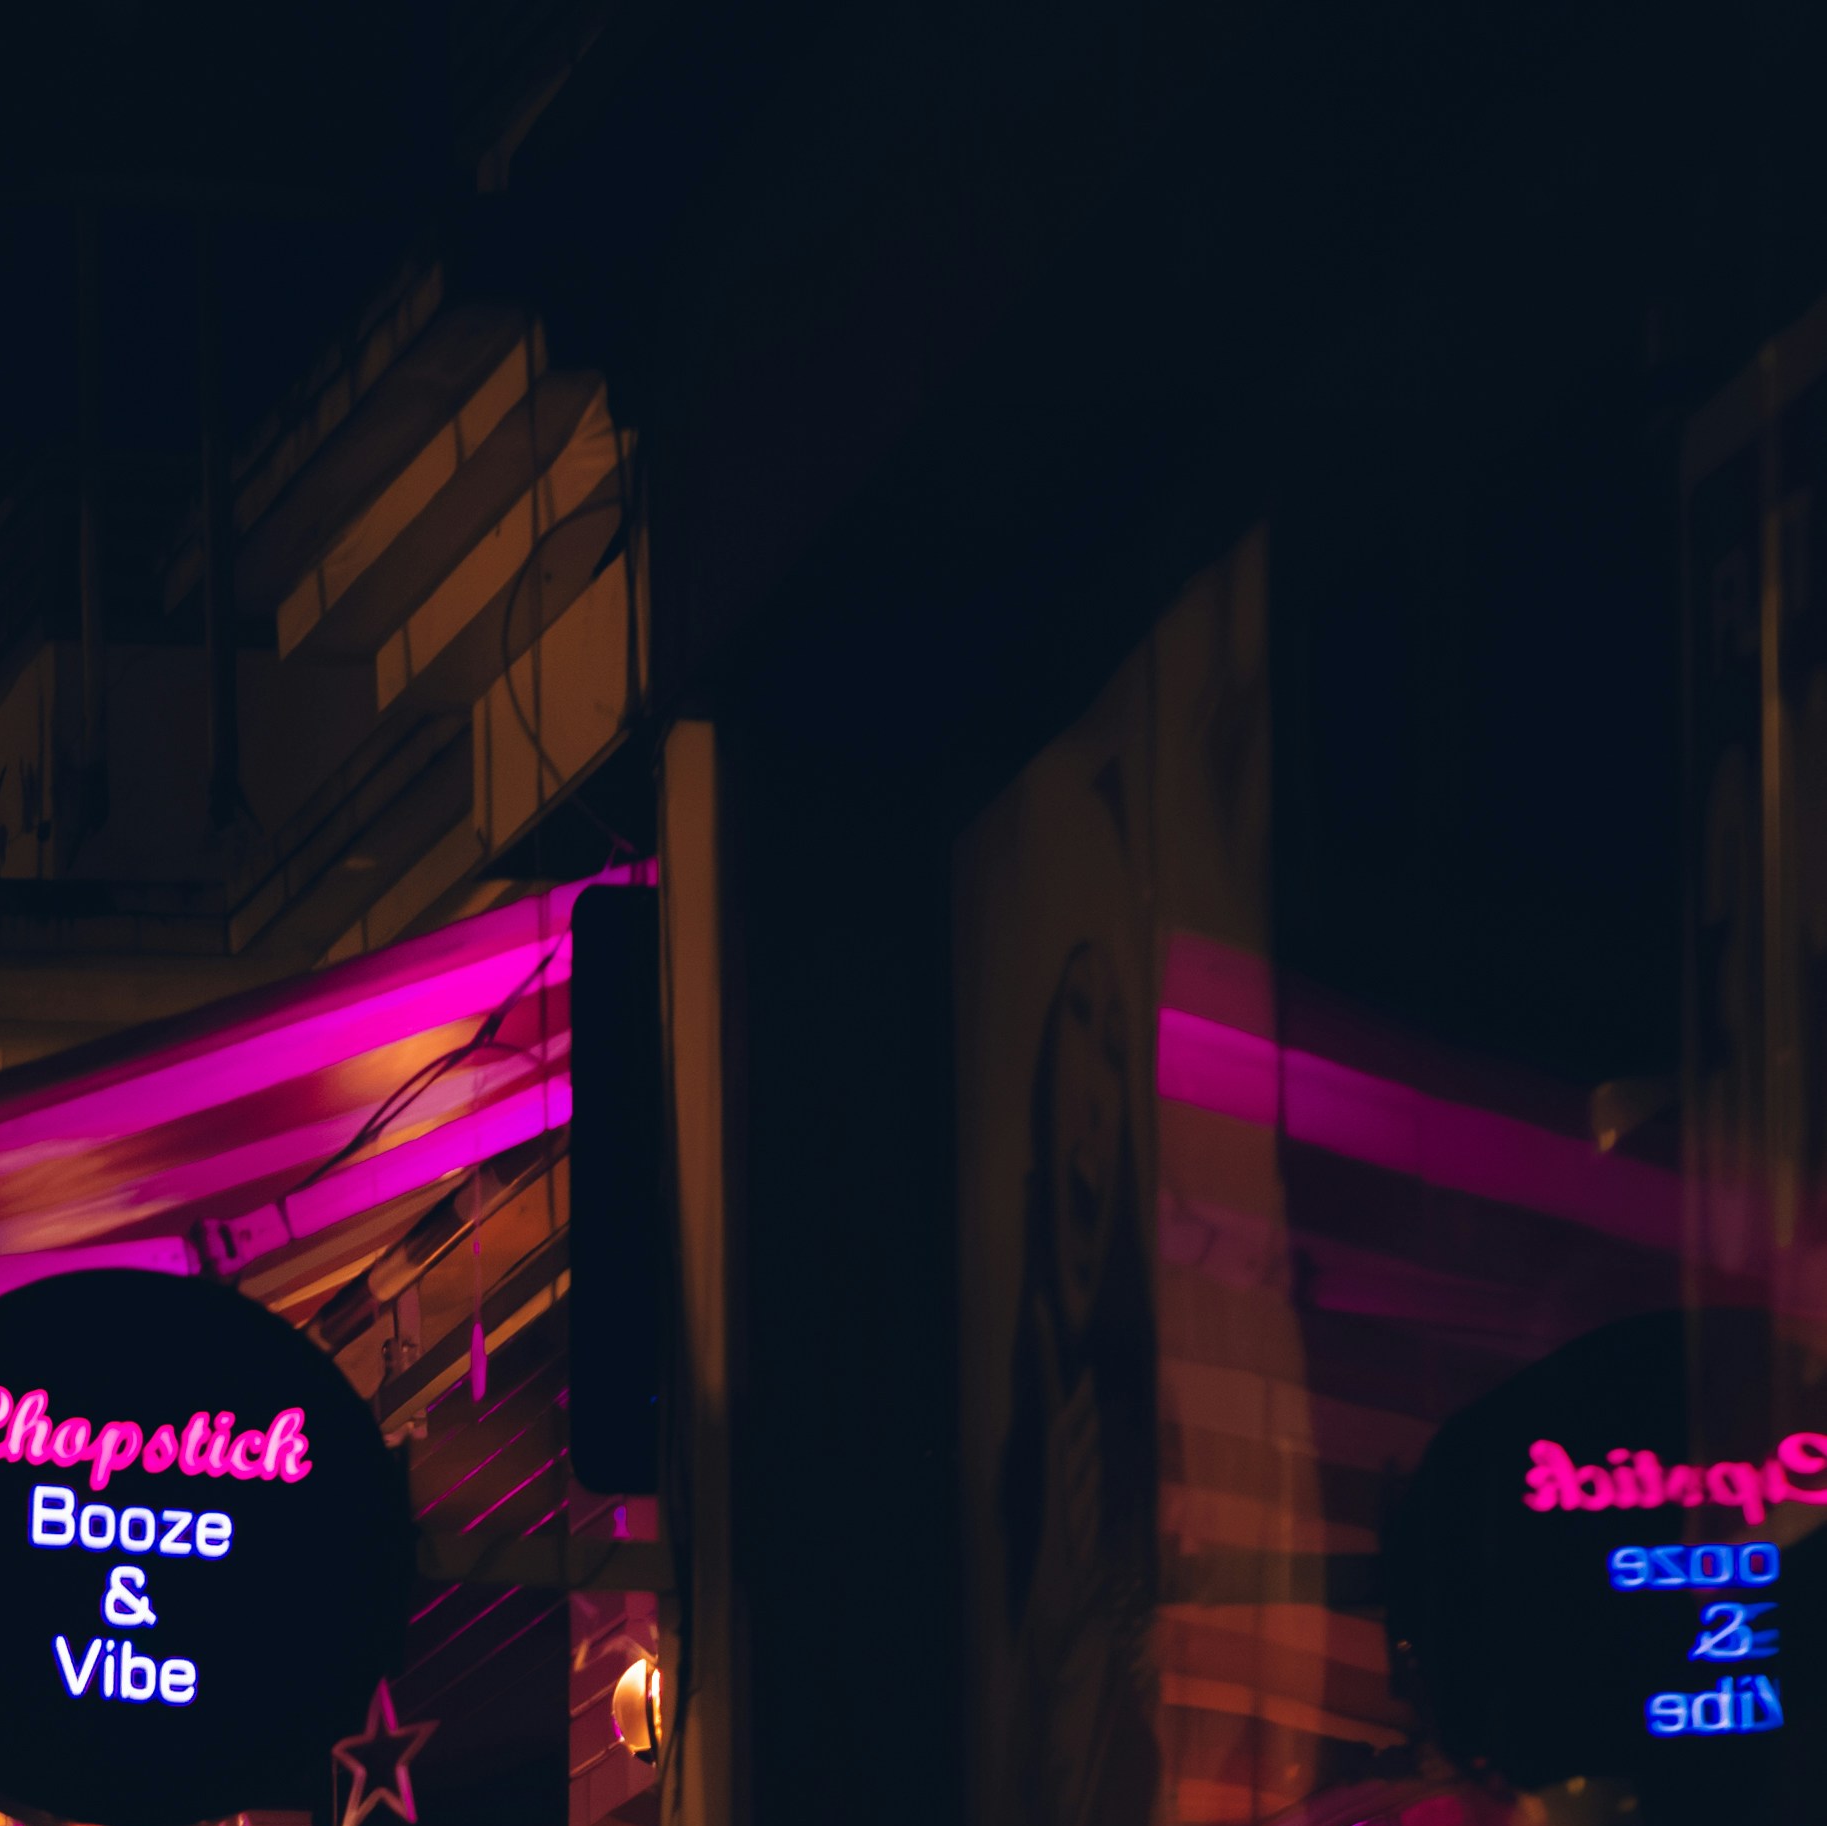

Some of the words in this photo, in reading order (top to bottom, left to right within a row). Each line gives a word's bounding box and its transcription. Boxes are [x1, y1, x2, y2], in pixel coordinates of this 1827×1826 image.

[27, 1483, 234, 1561] Booze
[100, 1563, 159, 1630] &
[52, 1634, 199, 1706] Vibe
